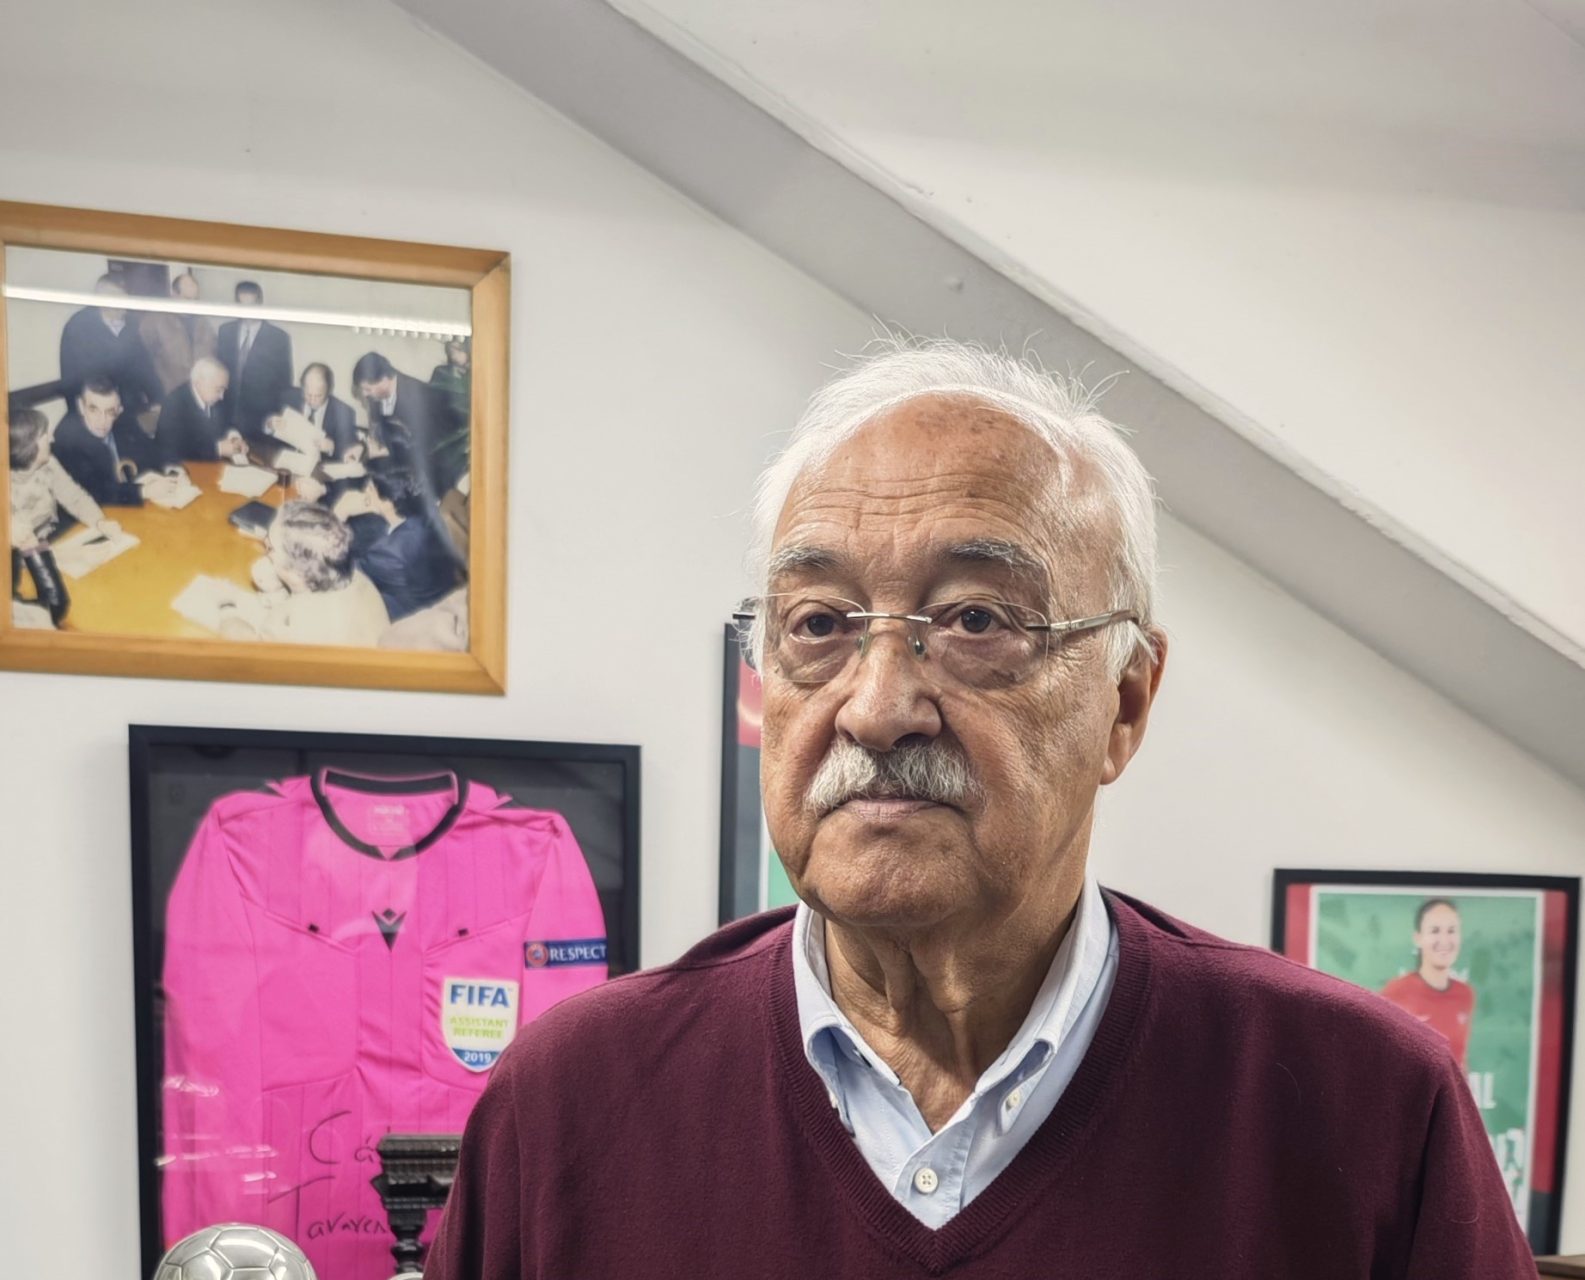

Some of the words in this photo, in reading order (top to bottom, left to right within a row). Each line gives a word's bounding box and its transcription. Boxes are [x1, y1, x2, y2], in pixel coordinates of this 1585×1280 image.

[550, 945, 607, 962] RESPECT
[450, 983, 510, 1008] FIFA
[450, 1015, 509, 1027] ASSISTANT
[453, 1027, 503, 1040] REFEREE
[463, 1051, 492, 1065] 2019
